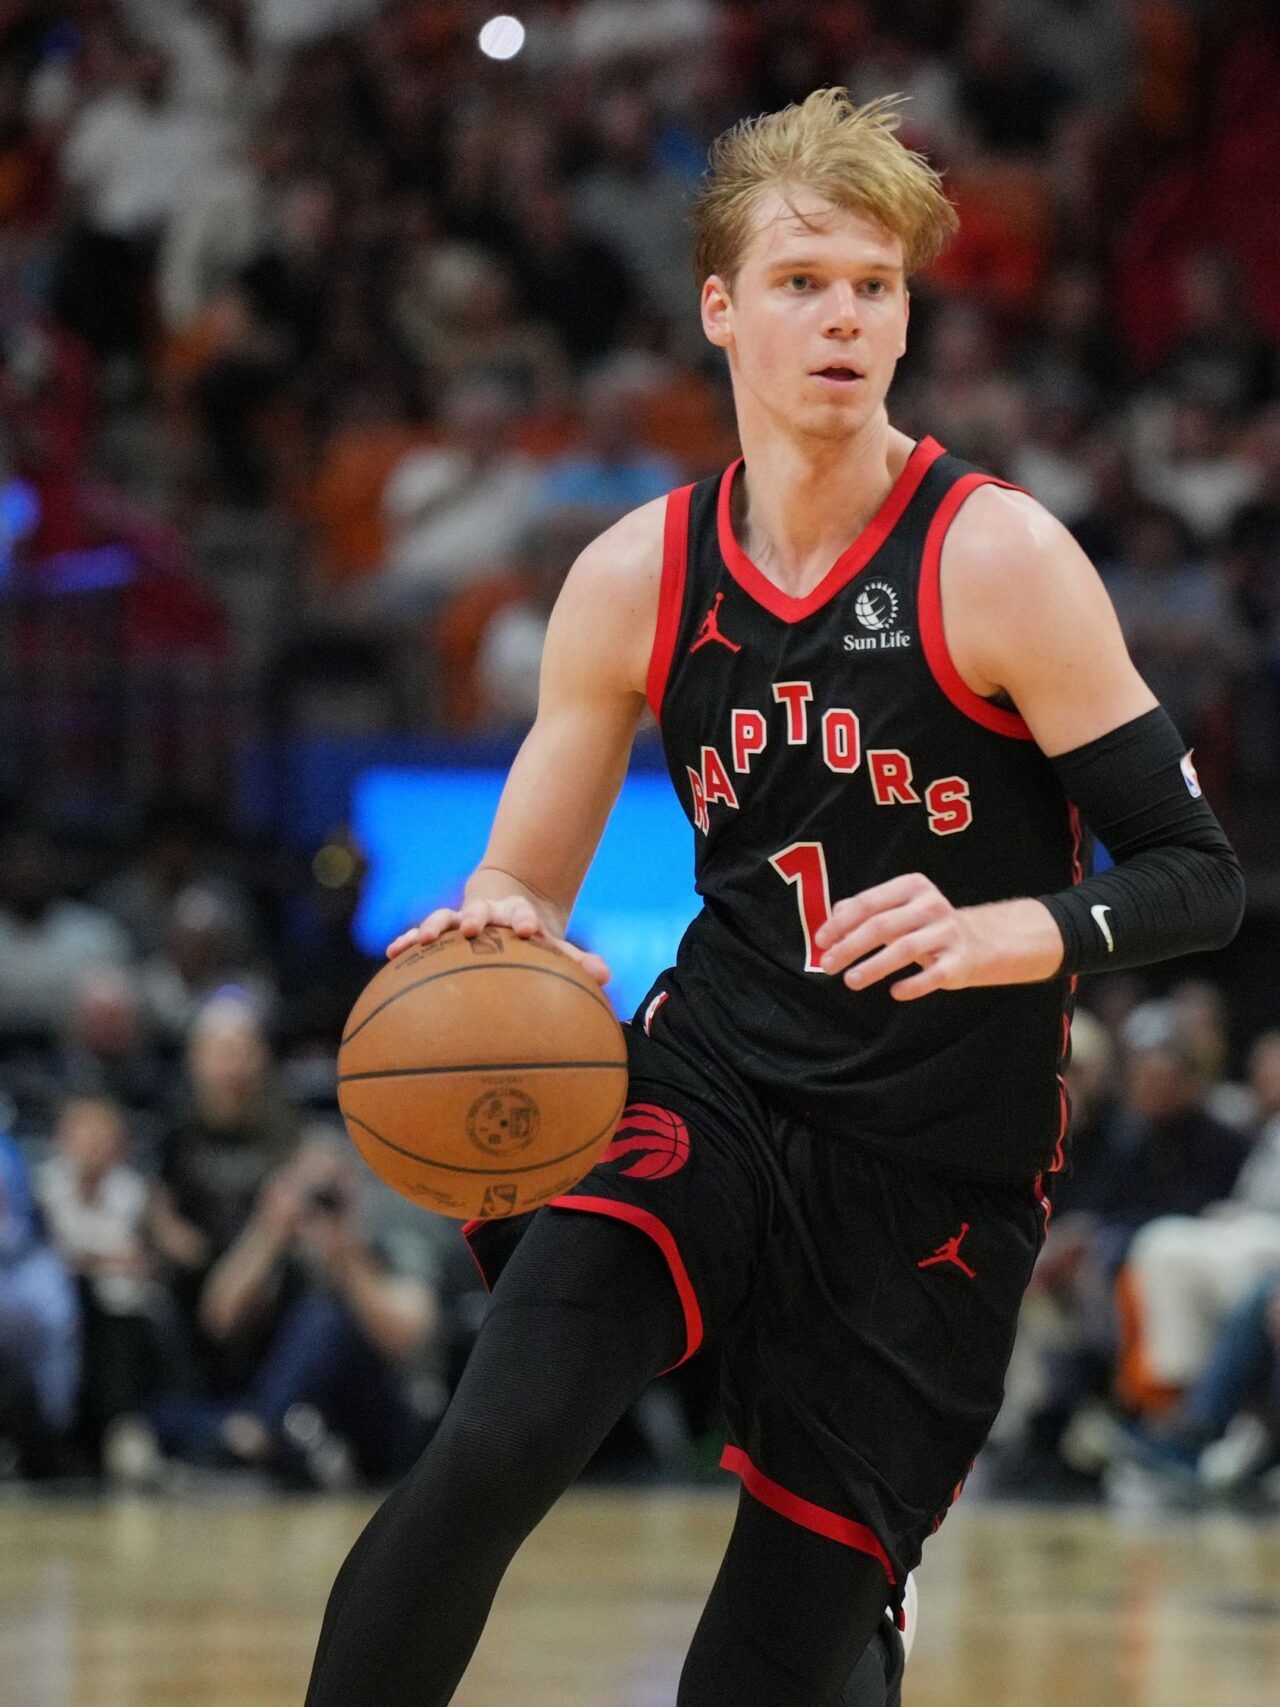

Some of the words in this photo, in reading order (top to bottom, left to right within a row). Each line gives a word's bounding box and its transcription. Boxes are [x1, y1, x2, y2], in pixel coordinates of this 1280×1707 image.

[843, 634, 877, 651] Sun
[880, 629, 911, 649] Life
[685, 680, 973, 837] RAPTORS
[768, 841, 833, 974] 1
